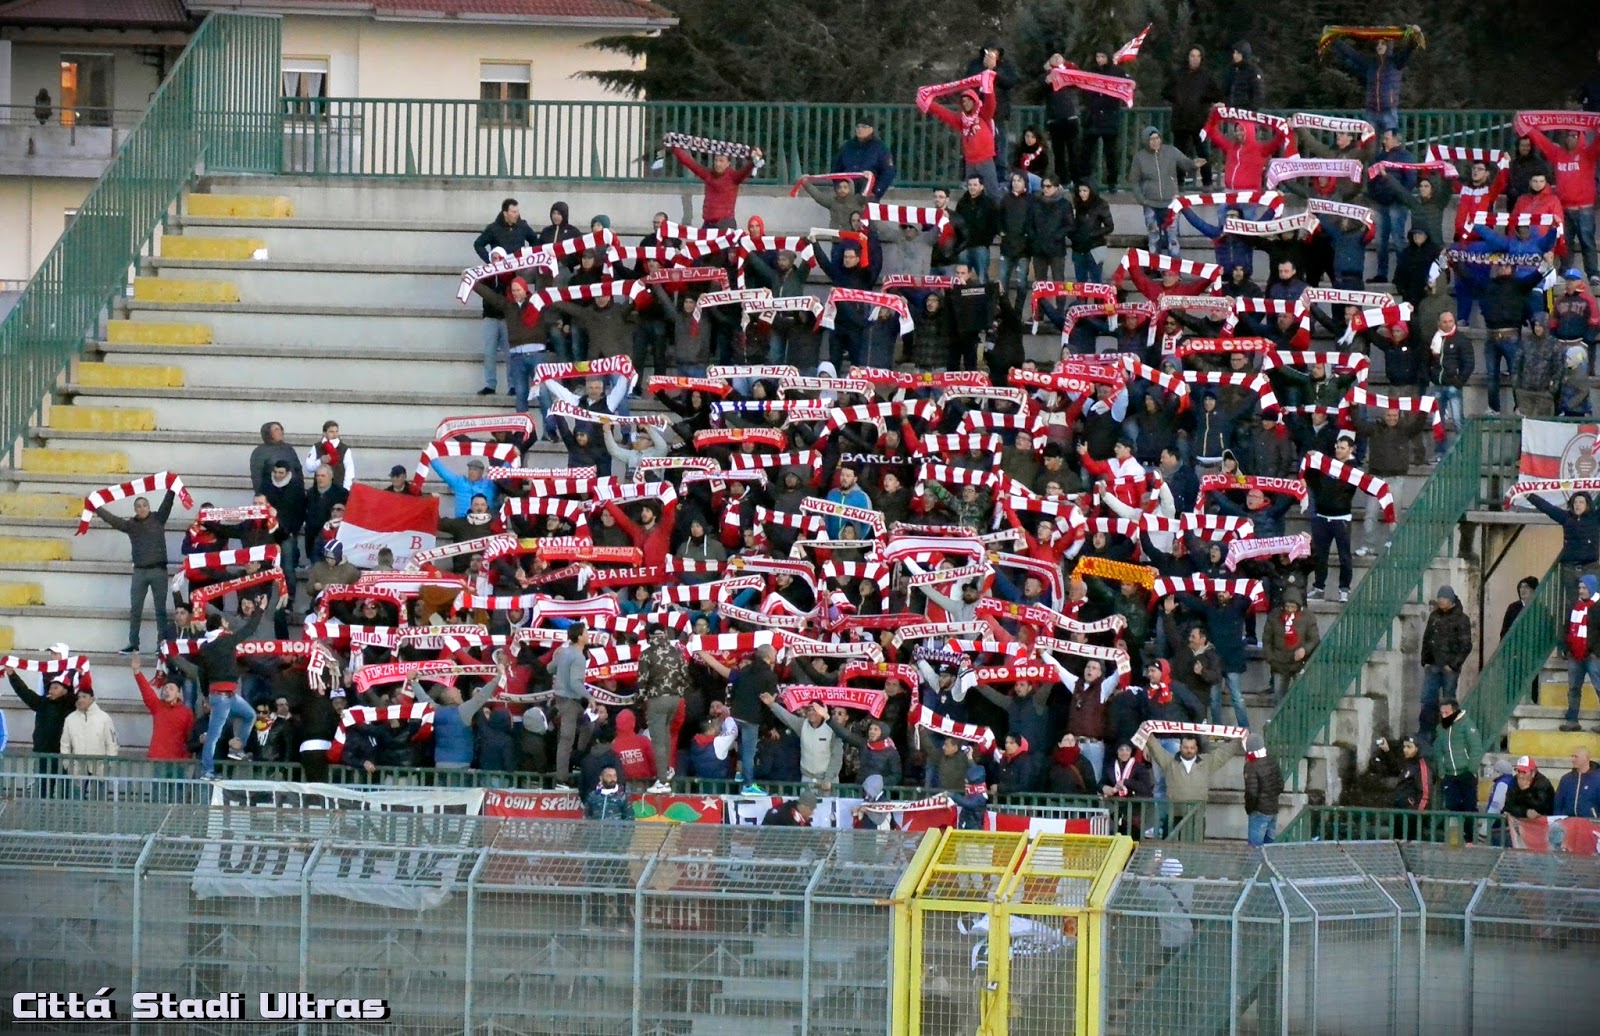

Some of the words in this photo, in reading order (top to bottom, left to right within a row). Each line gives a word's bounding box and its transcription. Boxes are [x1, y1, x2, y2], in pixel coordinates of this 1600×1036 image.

[1218, 107, 1288, 135] BARLETTA
[1296, 117, 1362, 131] BARLETTA
[1311, 201, 1365, 218] BARLETTA
[1225, 215, 1307, 233] BARLETTA
[462, 262, 500, 286] DIECI
[503, 256, 513, 270] &
[517, 252, 553, 271] LODE
[925, 275, 962, 284] urva
[698, 290, 769, 306] BARLET
[743, 299, 811, 311] ARLETTA
[1306, 291, 1391, 307] BARLETTA
[1221, 340, 1263, 351] SOLO
[1014, 370, 1052, 385] SOLO
[789, 409, 831, 421] BARL
[1256, 477, 1306, 496] EROTICO
[1512, 481, 1561, 494] RUPPO
[1573, 479, 1600, 489] ERO
[596, 567, 659, 580] BARLET
[354, 585, 387, 597] SOLO
[721, 604, 794, 624] BARLETTA
[902, 622, 989, 638] BARLETTA
[1057, 616, 1111, 631] LETTA
[236, 642, 276, 654] SOLO
[794, 641, 877, 655] BARLETTA
[366, 664, 395, 680] FORZA
[979, 669, 1008, 680] OLO
[794, 687, 823, 704] FORZA
[827, 690, 876, 706] BARLETTA
[1144, 721, 1246, 736] BARLETTA
[487, 791, 511, 806] in
[514, 796, 546, 811] ogni
